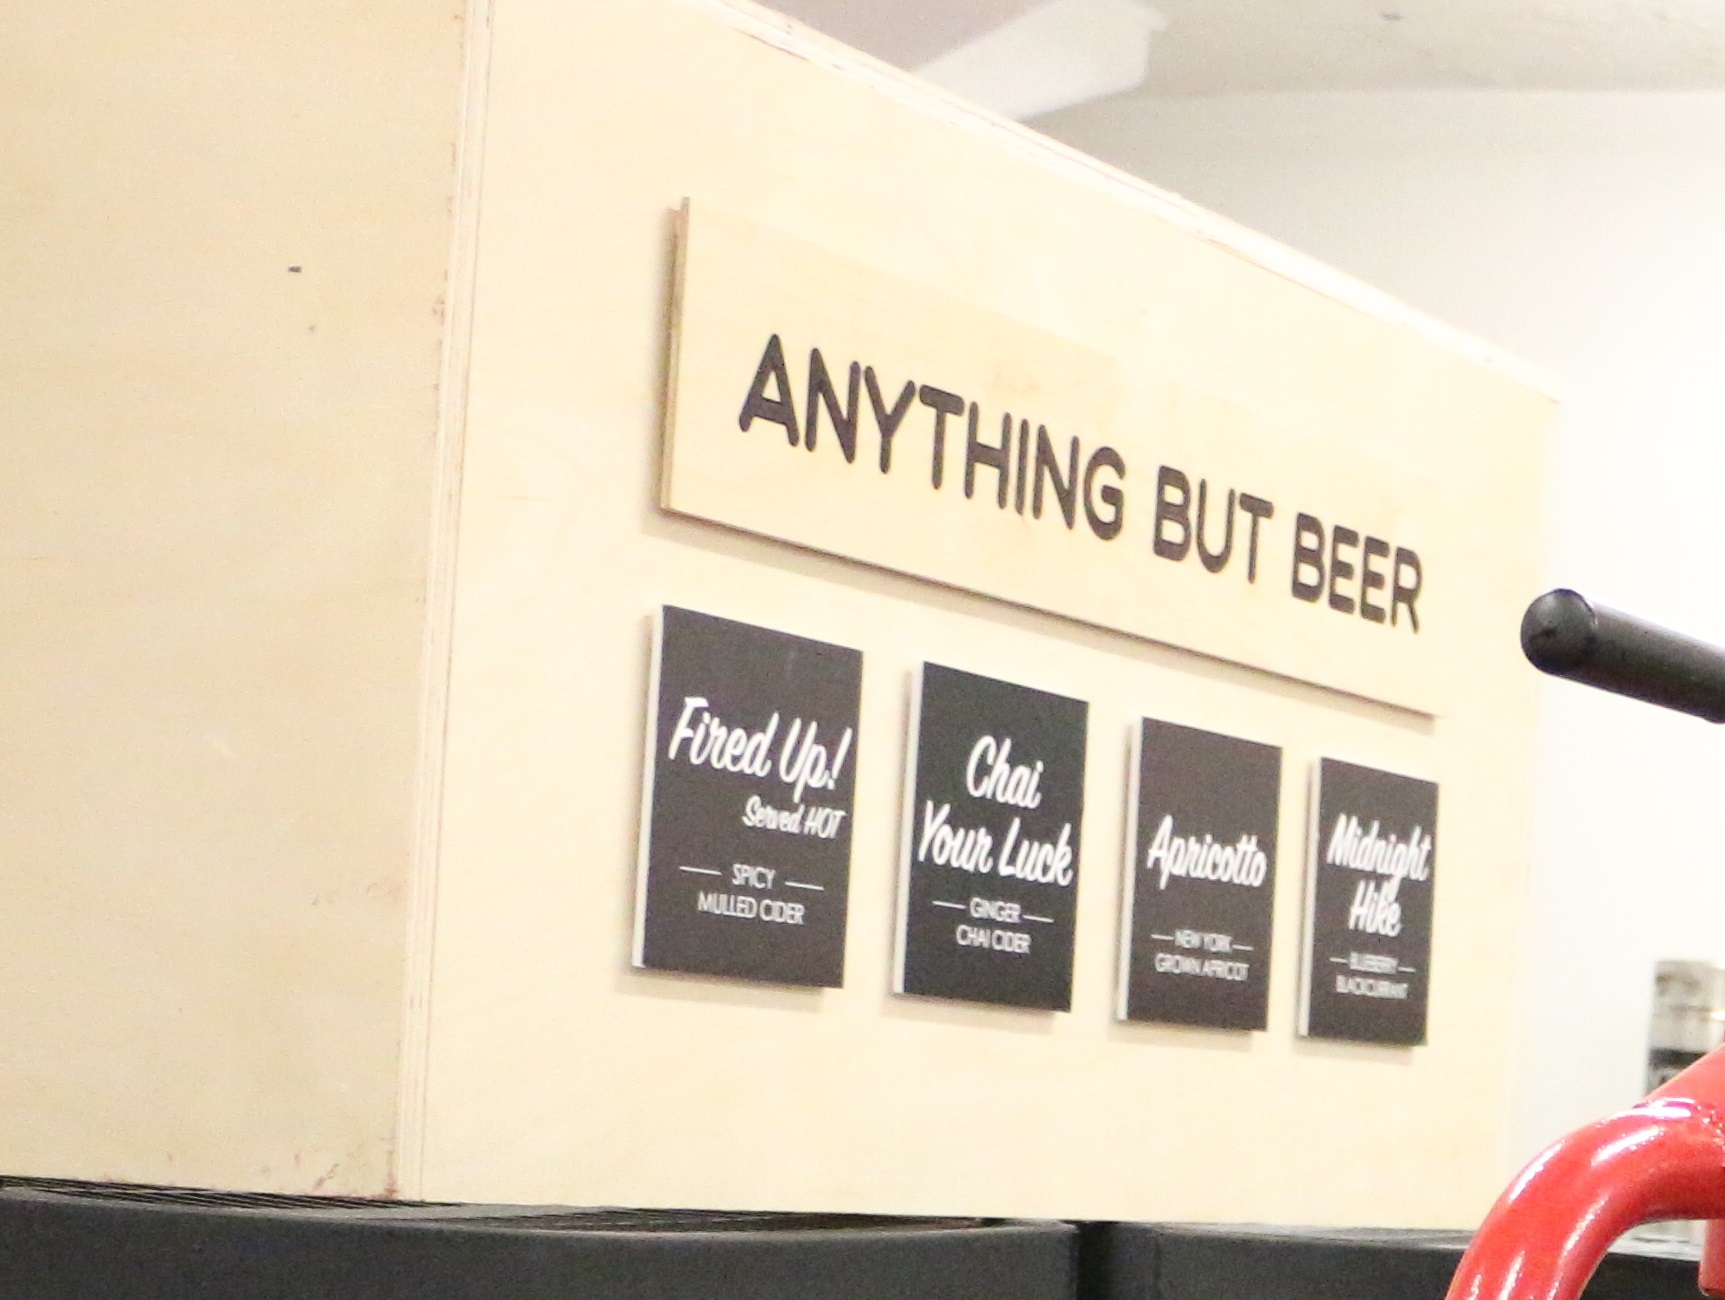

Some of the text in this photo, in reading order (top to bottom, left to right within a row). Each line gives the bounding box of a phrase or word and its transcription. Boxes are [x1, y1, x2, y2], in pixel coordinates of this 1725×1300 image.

[738, 333, 1423, 634] ANYTHING BUT BEER
[668, 696, 853, 804] Fired Up!
[966, 735, 1045, 810] Chai
[742, 794, 848, 840] Served HOT
[917, 799, 1074, 887] Your Luck
[731, 862, 777, 890] SPICY
[1146, 814, 1268, 891] Apricotto
[1326, 811, 1432, 902] Midnight
[697, 890, 806, 926] MULLED CIDER
[955, 924, 1031, 954] CHAI CIDER
[969, 897, 1022, 924] GINGER
[1348, 877, 1402, 938] Hike
